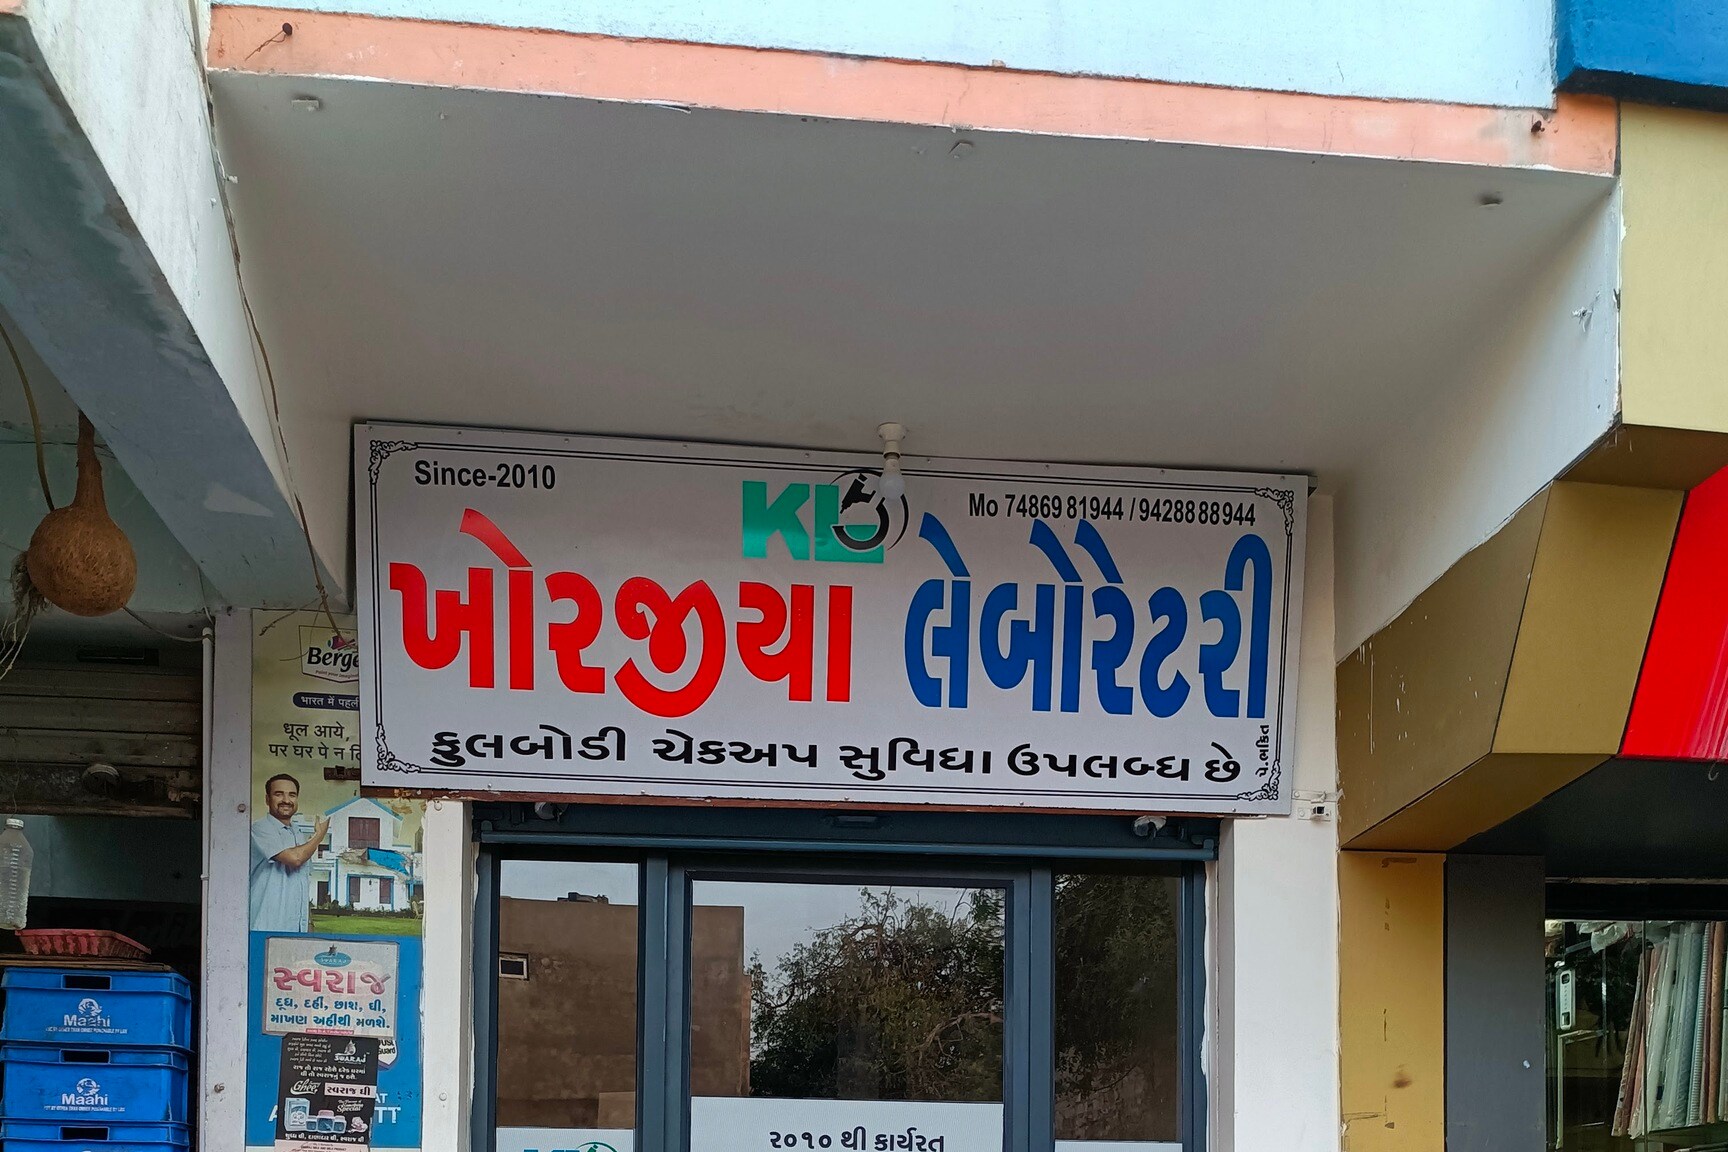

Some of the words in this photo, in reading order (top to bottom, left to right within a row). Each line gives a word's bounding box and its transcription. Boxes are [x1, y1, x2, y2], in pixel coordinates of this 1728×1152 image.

[414, 460, 556, 489] Since-2010
[969, 493, 998, 517] Mo
[389, 508, 852, 718] ખોરજીયા
[904, 512, 1273, 719] લેબોરેટરી
[307, 647, 359, 673] Berge
[301, 696, 324, 705] भारत
[327, 695, 335, 706] में
[283, 722, 309, 742] धूल
[269, 744, 288, 757] पर
[293, 745, 313, 758] घर
[318, 742, 330, 759] पे
[333, 749, 345, 760] न
[652, 729, 818, 768] ચેકઅપ
[839, 737, 991, 781] સુવિધા
[1007, 743, 1190, 782] ઉપલબ્ધ
[1204, 742, 1241, 783] છે
[273, 967, 391, 994] સ્વરાજ
[270, 1014, 307, 1025] માખણ
[62, 1093, 108, 1105] Maahi
[326, 1086, 356, 1094] સ્વરાજ
[360, 1086, 371, 1096] ઘી
[841, 1126, 866, 1150] થી
[874, 1127, 944, 1152] કાર્યરત
